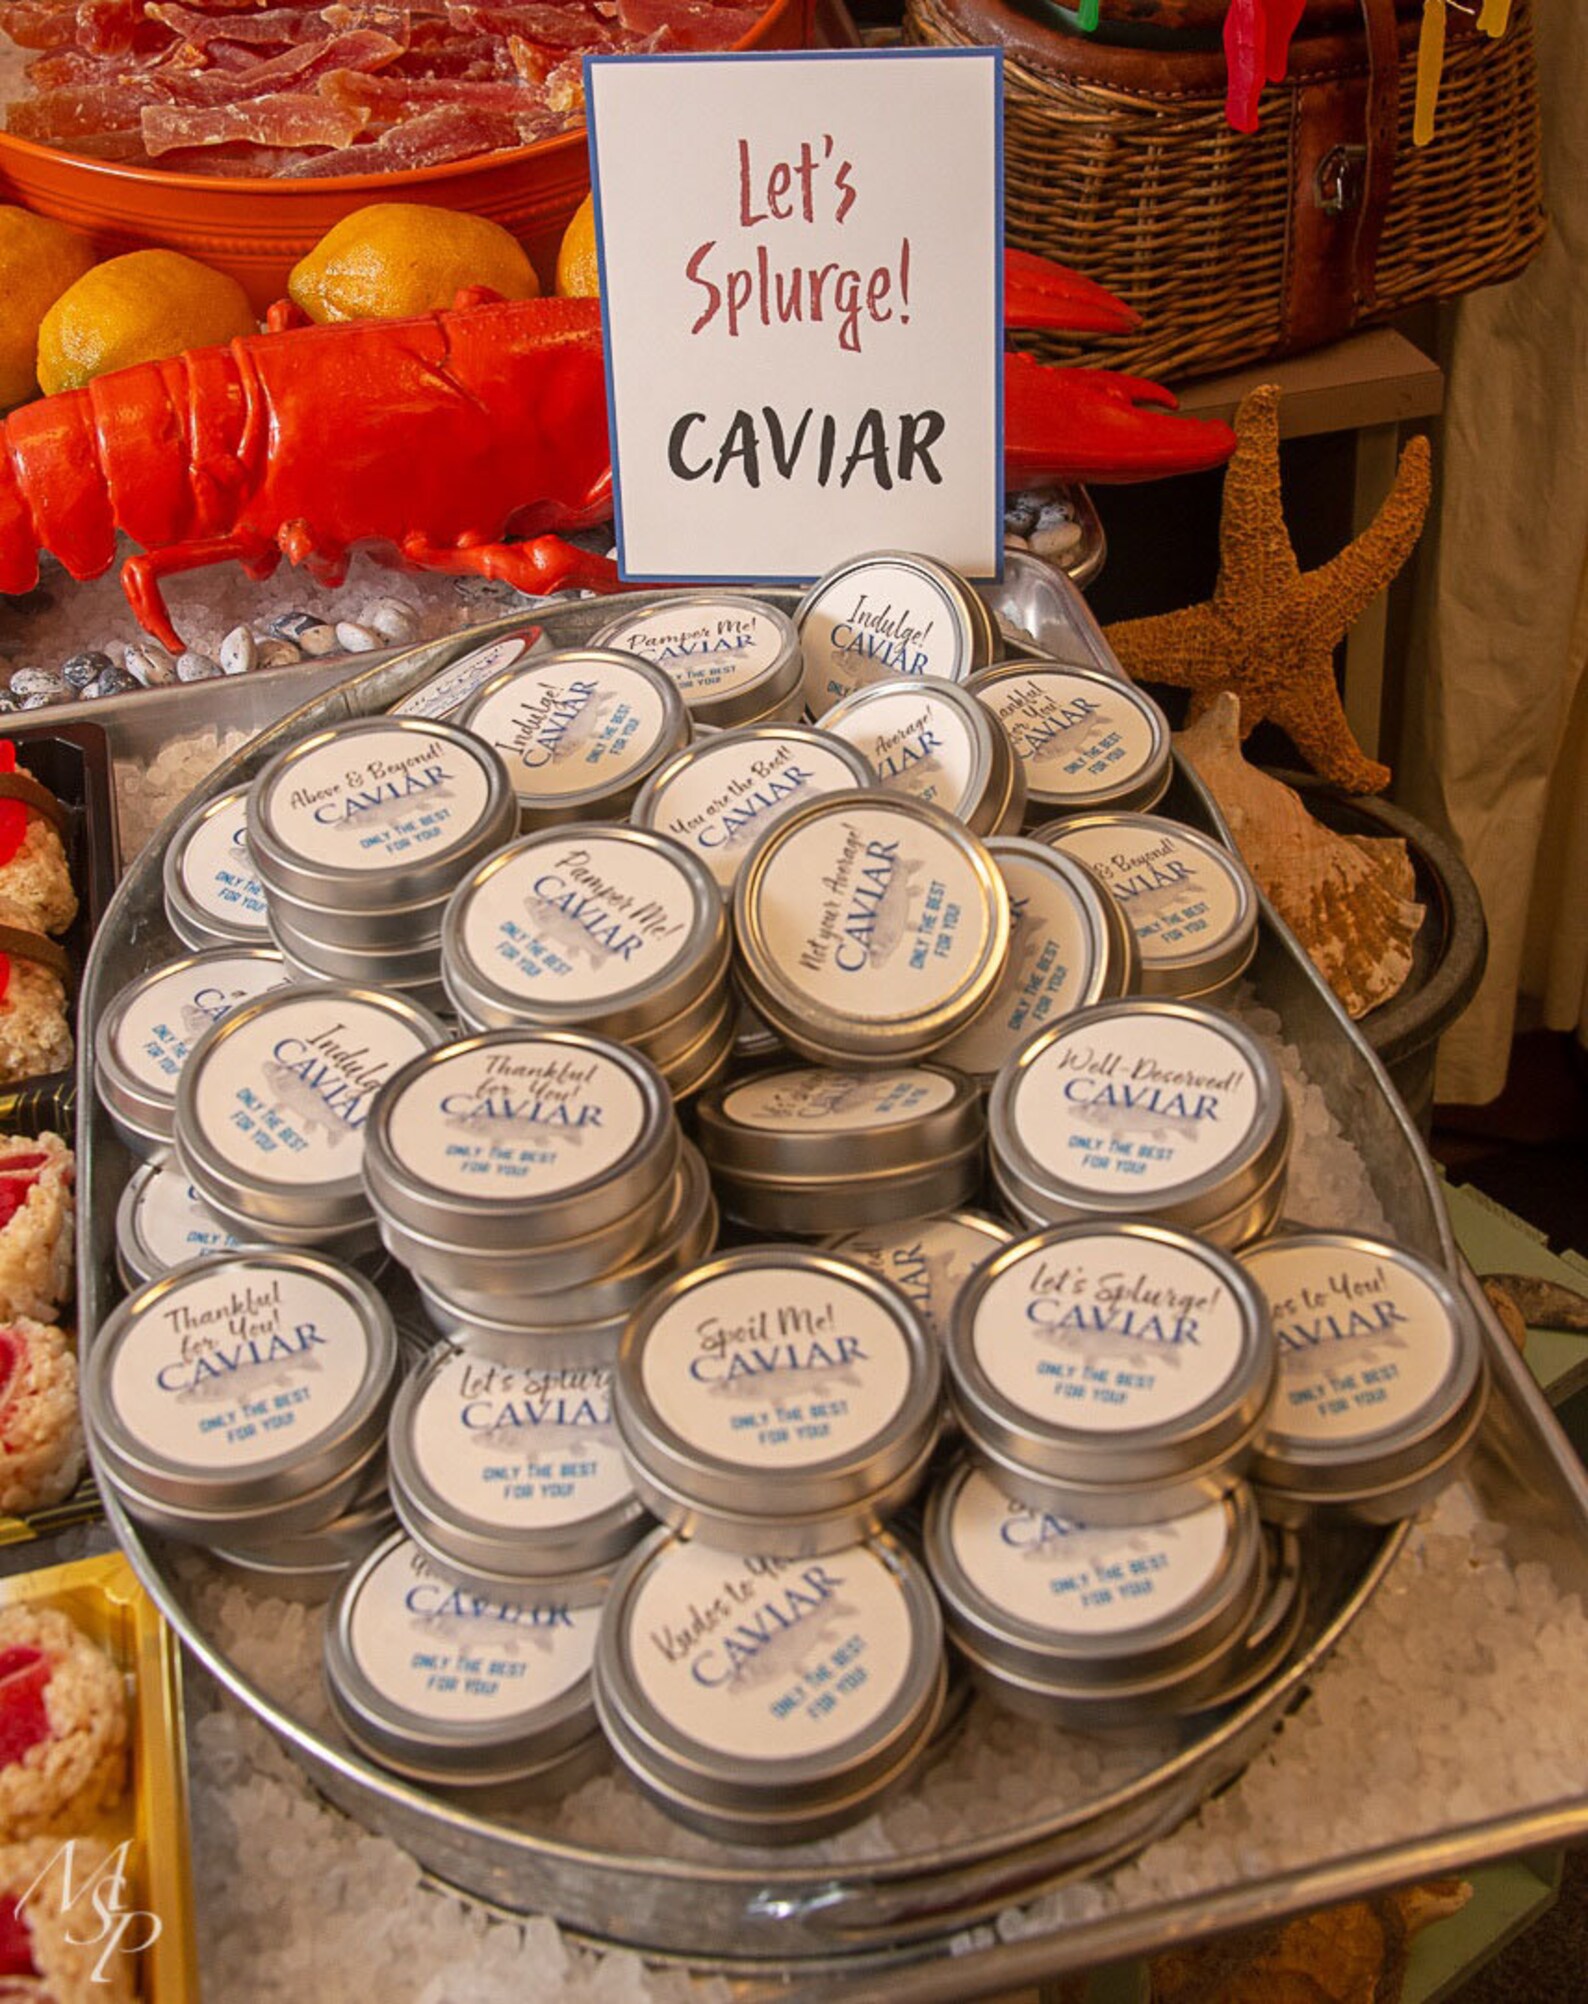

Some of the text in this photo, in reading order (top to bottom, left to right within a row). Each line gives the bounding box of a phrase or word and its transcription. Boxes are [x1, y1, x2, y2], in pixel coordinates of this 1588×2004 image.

[738, 134, 857, 227] Let's
[685, 237, 910, 353] Splurge!
[667, 406, 945, 490] CAVIAR
[627, 617, 757, 651] Pamper Me!
[847, 595, 934, 654] Indulge!
[831, 624, 929, 675] CAVIAR
[495, 682, 564, 756] Indulge!
[523, 681, 599, 767] CAVIAR
[876, 704, 935, 757] Average!
[290, 783, 341, 811] Above
[366, 741, 446, 781] Beyond!
[314, 764, 456, 825] CAVIAR
[669, 746, 796, 836] You are the Best!
[359, 808, 451, 849] ONLY THE BEST
[697, 765, 815, 848] CAVIAR
[386, 838, 411, 853] FOR
[1110, 837, 1176, 874] Beyond!
[533, 875, 644, 962] CAVIAR
[554, 850, 686, 942] Pamper Me!
[798, 822, 866, 972] Not your Average!
[834, 840, 900, 973] CAVIAR
[909, 880, 946, 970] ONLY THE BEST
[1161, 913, 1183, 927] THE
[496, 941, 521, 960] FOR
[500, 921, 574, 977] ONLY THE BEST
[934, 933, 953, 959] FOR
[305, 1023, 384, 1096] Indulg
[486, 1054, 599, 1084] Thankful
[439, 1093, 604, 1128] CAVIAR
[475, 1077, 581, 1102] for You!
[1063, 1078, 1220, 1121] CAVIAR
[230, 1110, 256, 1132] FOR
[236, 1087, 310, 1153] ONLY THE BEST
[446, 1144, 557, 1165] ONLY THE BEST
[461, 1160, 490, 1174] FOR
[1068, 1135, 1174, 1161] ONLY THE BEST
[1082, 1153, 1110, 1168] FOR
[164, 1280, 283, 1334] Thankful
[1029, 1261, 1222, 1321] Let's Splurge!
[1301, 1287, 1329, 1310] to
[1328, 1264, 1390, 1300] You!
[181, 1309, 281, 1364] for You!
[697, 1303, 835, 1360] Spoil Me!
[1026, 1298, 1201, 1346] CAVIAR
[1277, 1300, 1410, 1351] AVIAR
[157, 1322, 328, 1392] CAVIAR
[690, 1336, 870, 1383] CAVIAR
[1036, 1359, 1156, 1389] ONLY THE BEST
[1054, 1382, 1086, 1399] FOR
[1288, 1363, 1398, 1405] ONLY THE BEST
[1317, 1398, 1348, 1416] FOR
[199, 1387, 312, 1434] ONLY THE BEST
[461, 1398, 612, 1430] CAVIA
[730, 1400, 849, 1431] ONLY THE BEST
[226, 1425, 256, 1444] FOR
[758, 1429, 789, 1445] FOR
[482, 1461, 598, 1482] ONLY THE BEST
[504, 1484, 534, 1499] FOR
[1050, 1553, 1169, 1594] ONLY THE BEST
[1080, 1589, 1113, 1607] FOR
[650, 1580, 755, 1664] Kudos to
[691, 1565, 846, 1688] CAVIAR
[411, 1653, 527, 1679] ONLY THE BEST
[426, 1675, 458, 1692] FOR
[769, 1634, 868, 1720] ONLY THE BEST
[807, 1691, 837, 1720] FOR
